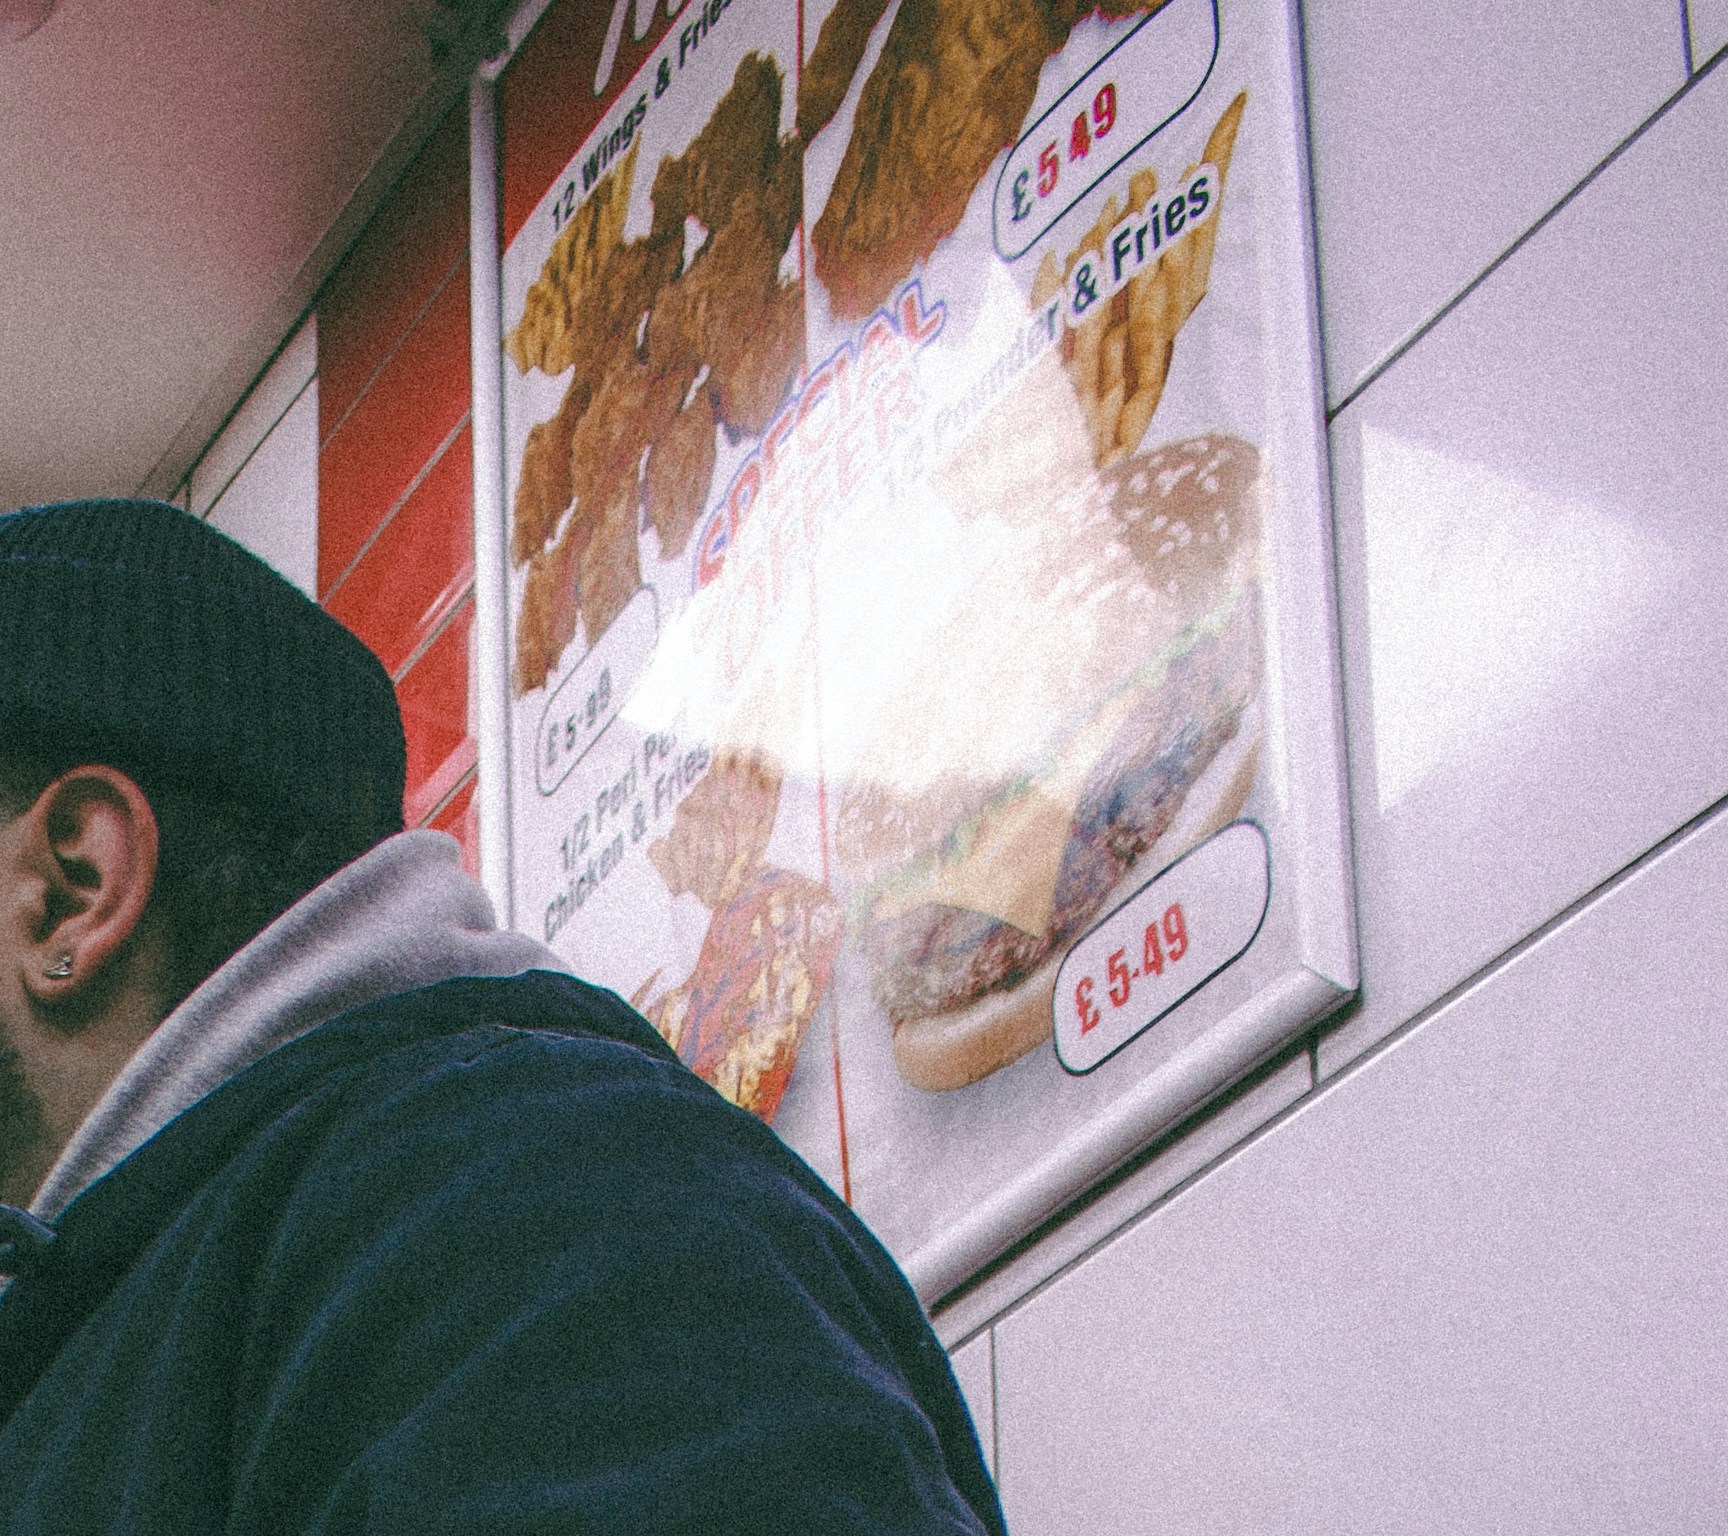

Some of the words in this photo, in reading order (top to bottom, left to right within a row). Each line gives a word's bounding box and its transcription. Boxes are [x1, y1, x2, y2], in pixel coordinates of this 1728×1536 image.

[551, 181, 575, 230] 12
[581, 91, 647, 188] Wings
[654, 57, 671, 99] &
[1072, 262, 1098, 315] &
[1113, 177, 1209, 281] Fries
[545, 832, 623, 942] Chicken
[1074, 901, 1188, 1038] £5.49
